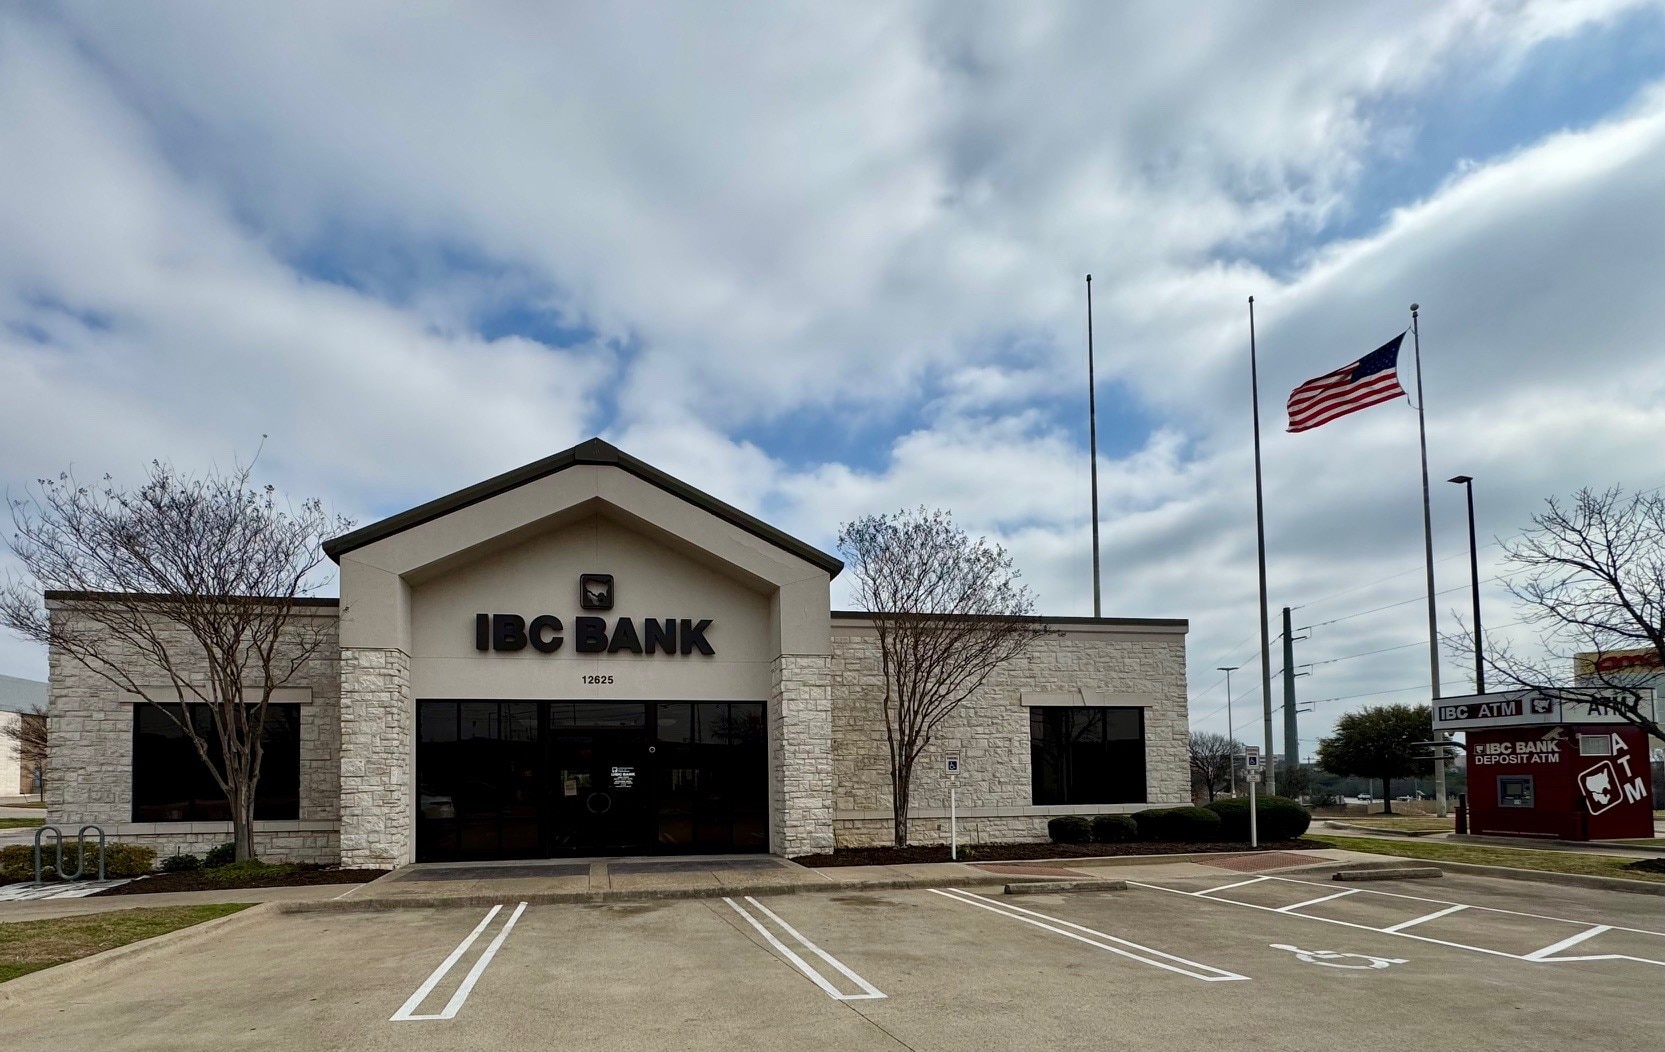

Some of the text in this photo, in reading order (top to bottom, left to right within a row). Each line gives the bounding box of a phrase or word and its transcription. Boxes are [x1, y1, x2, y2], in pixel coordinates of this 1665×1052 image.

[475, 613, 716, 655] IBC BANK
[581, 675, 615, 685] 12625
[1441, 701, 1516, 720] IBC ATM
[1486, 740, 1561, 755] IBC BANK
[1475, 753, 1559, 765] DEPOSIT ATM
